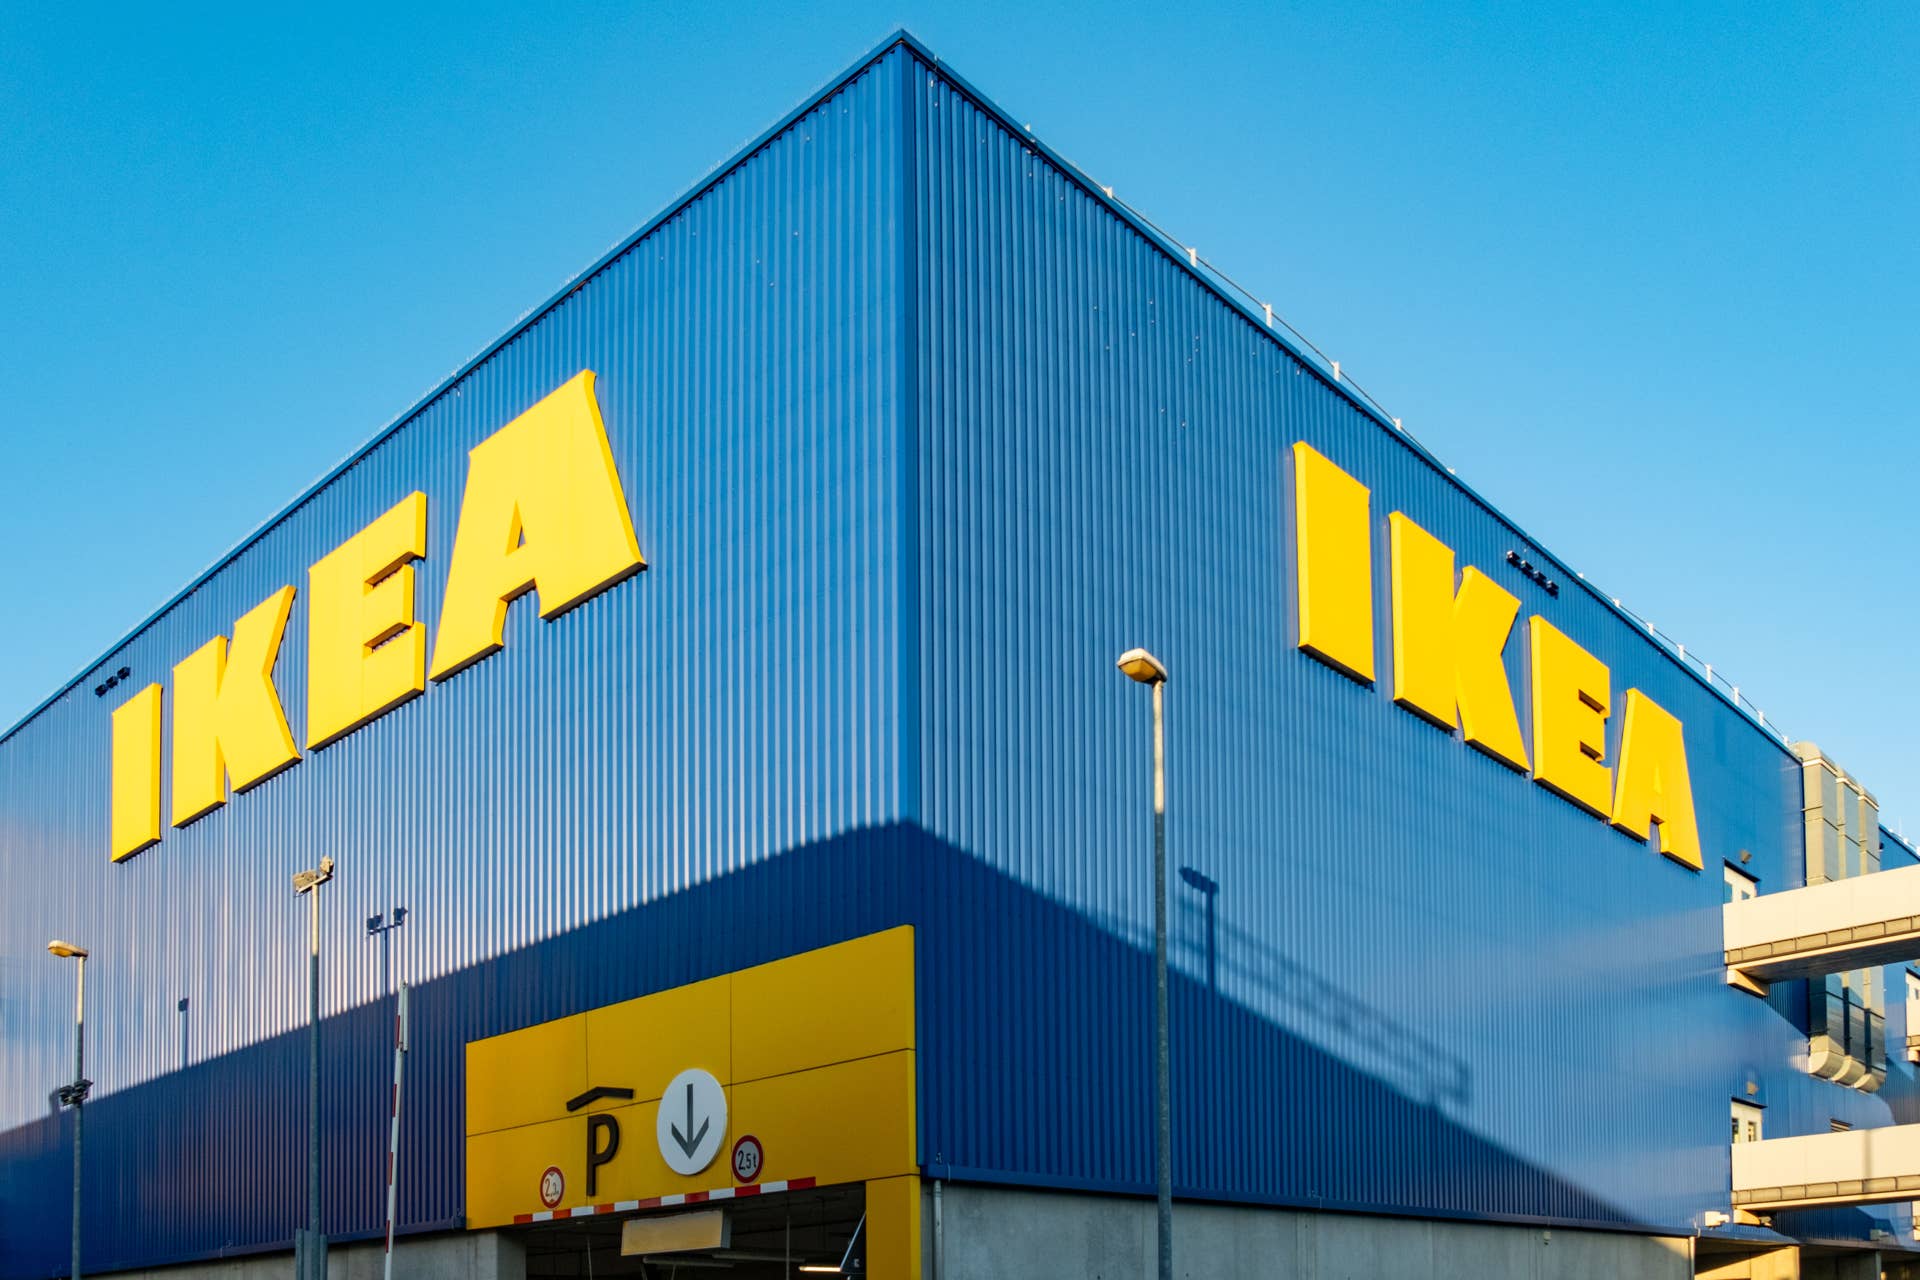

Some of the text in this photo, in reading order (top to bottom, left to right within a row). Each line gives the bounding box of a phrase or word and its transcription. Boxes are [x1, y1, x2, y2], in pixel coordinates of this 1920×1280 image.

[111, 369, 648, 863] IKEA
[1293, 440, 1704, 871] IKEA
[586, 1113, 620, 1197] P
